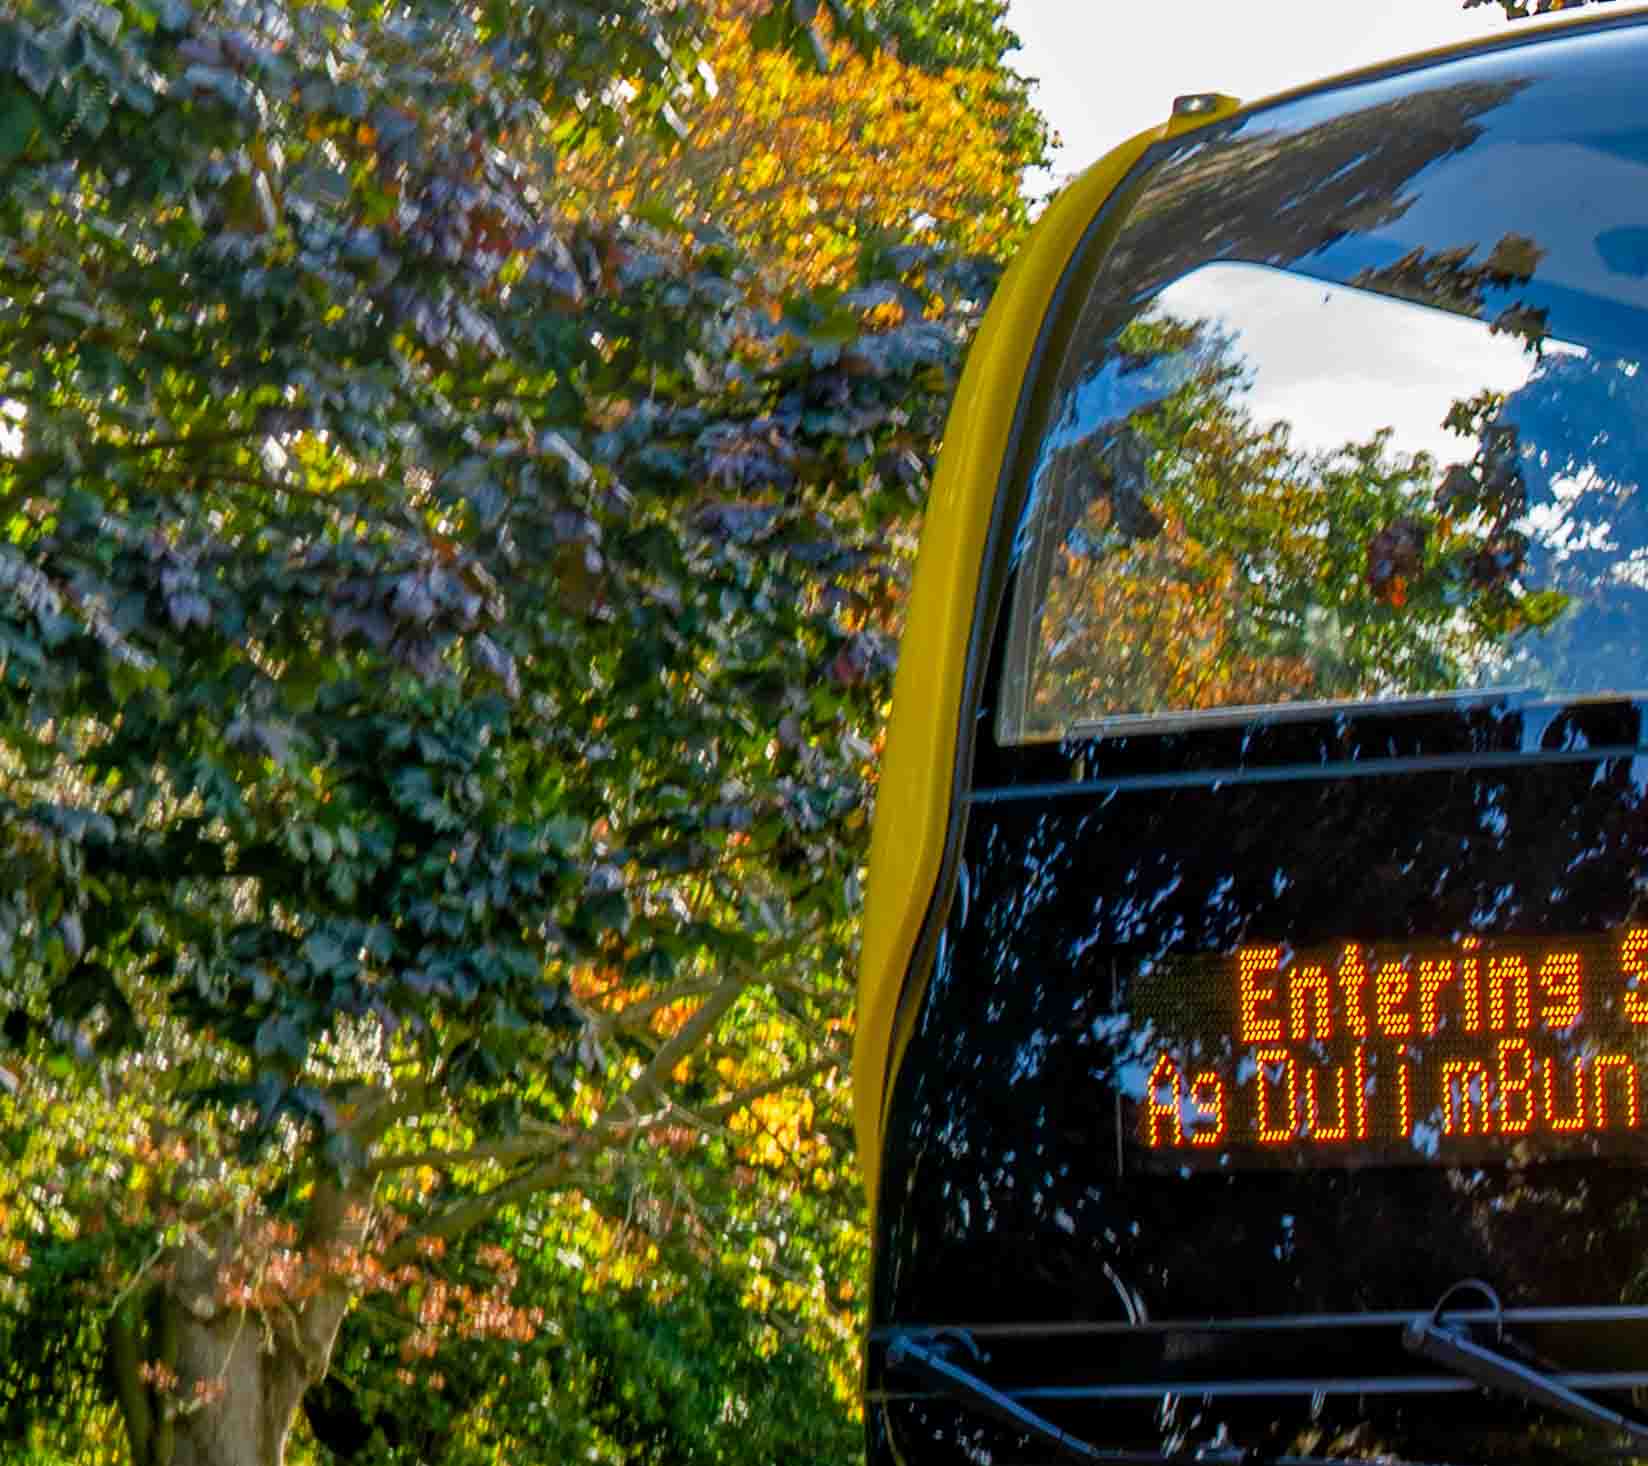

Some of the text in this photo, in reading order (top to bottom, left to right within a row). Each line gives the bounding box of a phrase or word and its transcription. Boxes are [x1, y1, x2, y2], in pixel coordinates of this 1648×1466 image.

[1238, 937, 1582, 1043] Entering
[1256, 1046, 1368, 1142] Dul
[1442, 1038, 1640, 1136] mBun
